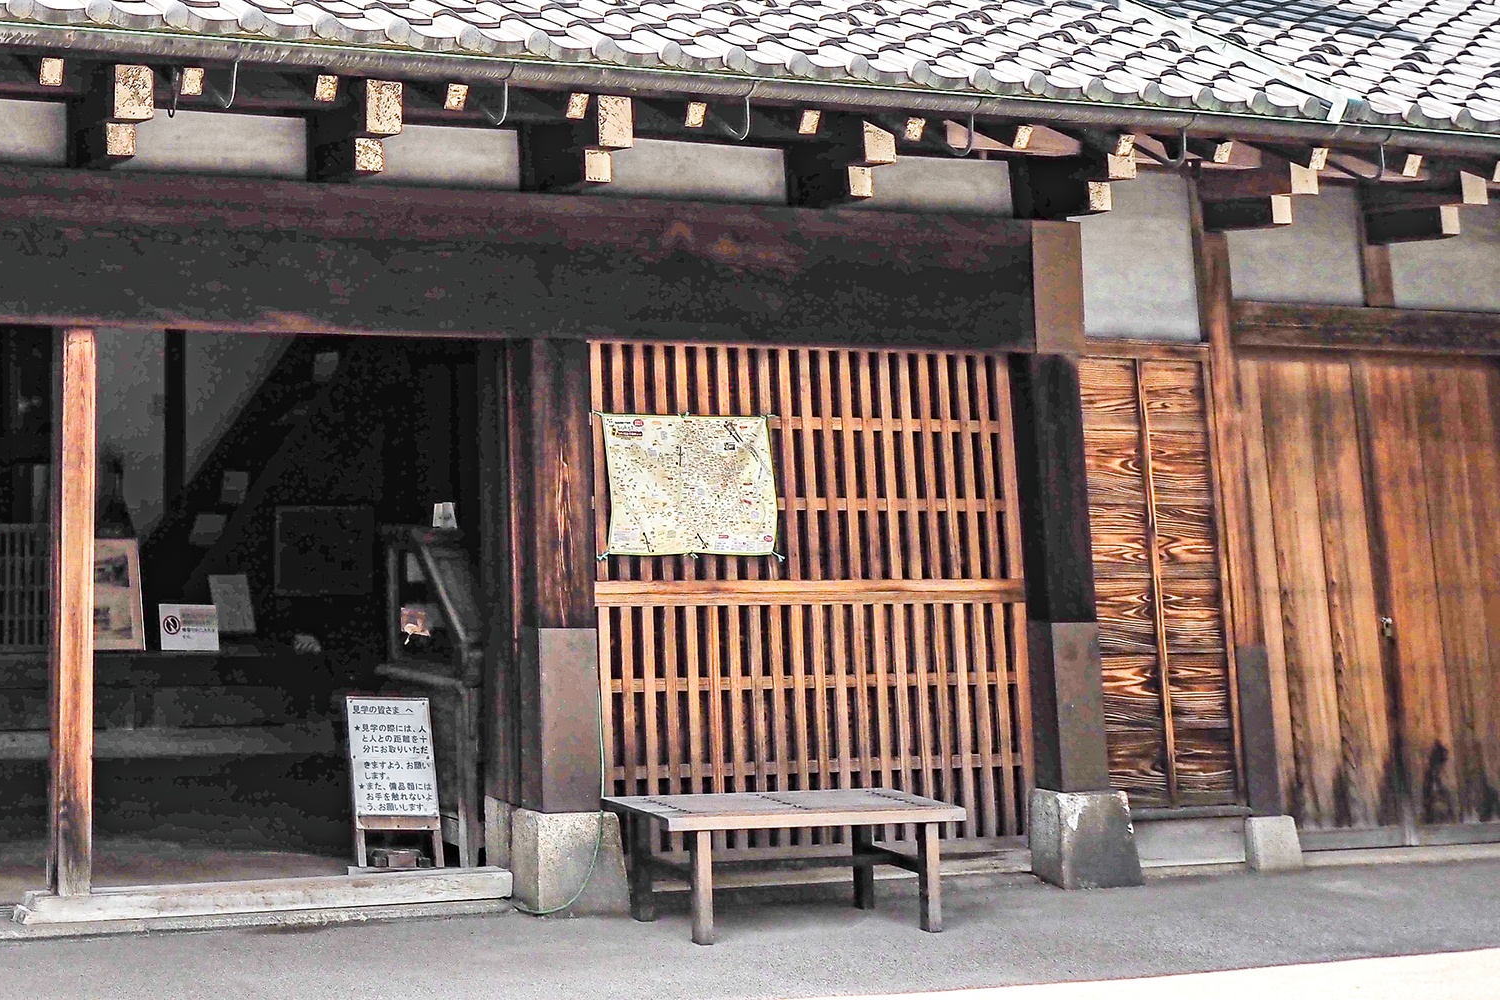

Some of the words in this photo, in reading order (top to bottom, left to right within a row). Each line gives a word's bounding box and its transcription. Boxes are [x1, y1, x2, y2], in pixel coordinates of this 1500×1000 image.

[352, 705, 400, 715] 見学の皆さま
[361, 724, 428, 733] 見学の際には、人
[361, 734, 428, 743] と人との距離を十
[362, 745, 429, 754] 分にお取りいただ
[363, 761, 431, 770] きますよう、お願い
[364, 772, 391, 780] します。
[366, 782, 433, 791] また、備品類には
[366, 792, 433, 801] お手を触れないよ
[367, 803, 428, 812] う、お願いします。
